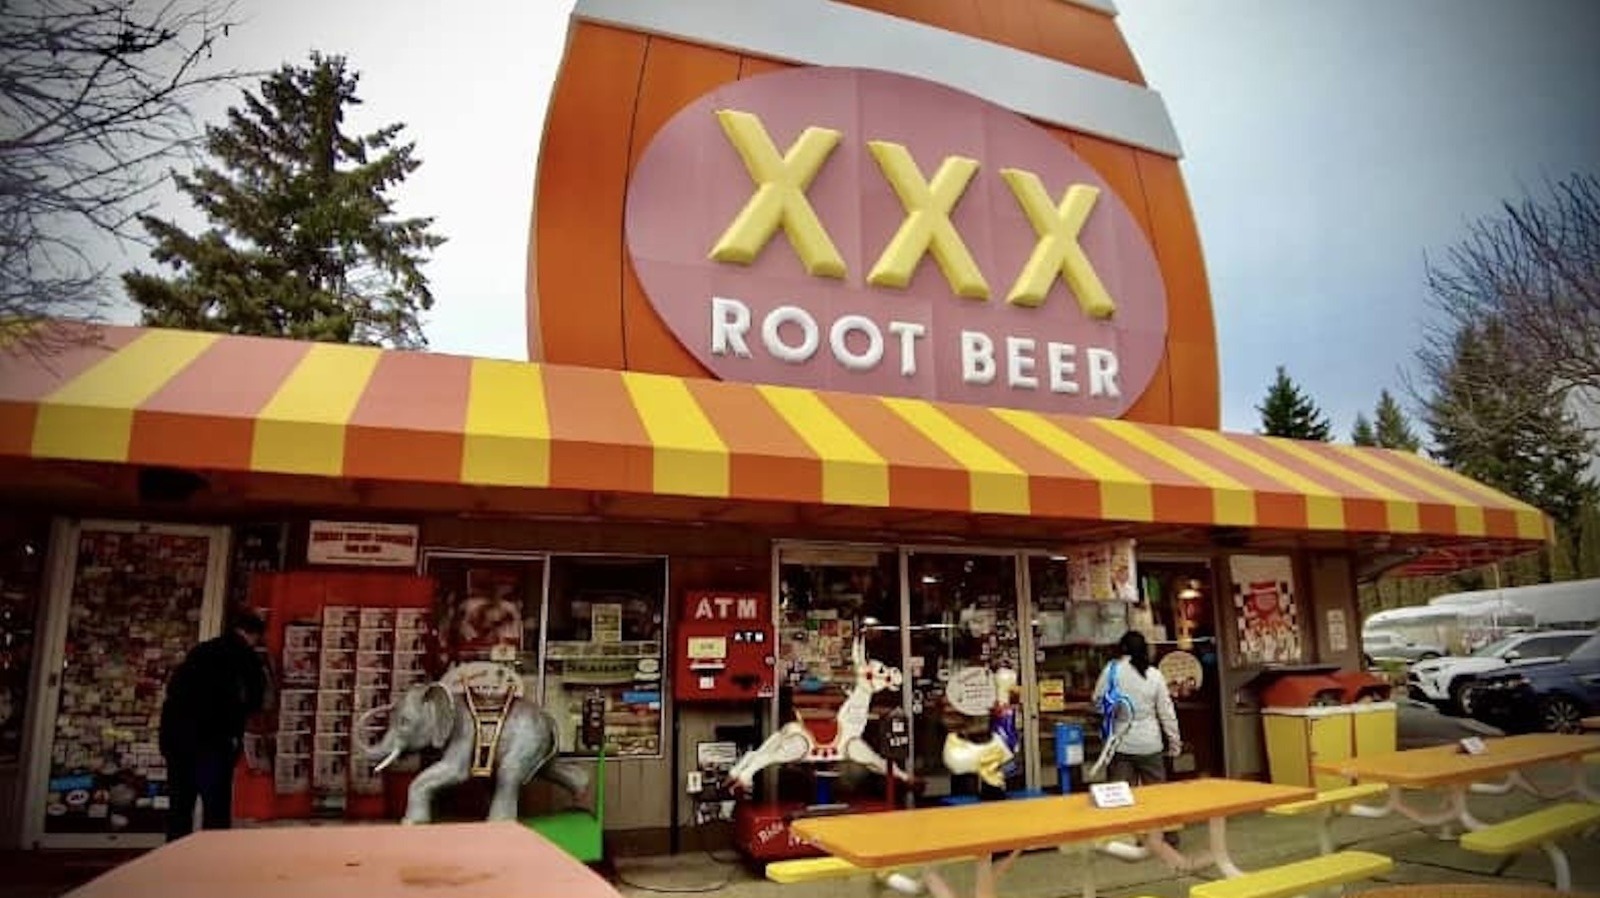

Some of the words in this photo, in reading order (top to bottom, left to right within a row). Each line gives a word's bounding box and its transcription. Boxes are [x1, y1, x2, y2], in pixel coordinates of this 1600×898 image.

[708, 109, 1117, 320] XXX
[710, 297, 925, 377] ROOT
[961, 331, 1121, 398] BEER
[695, 597, 758, 619] ATM
[734, 631, 764, 642] ATM
